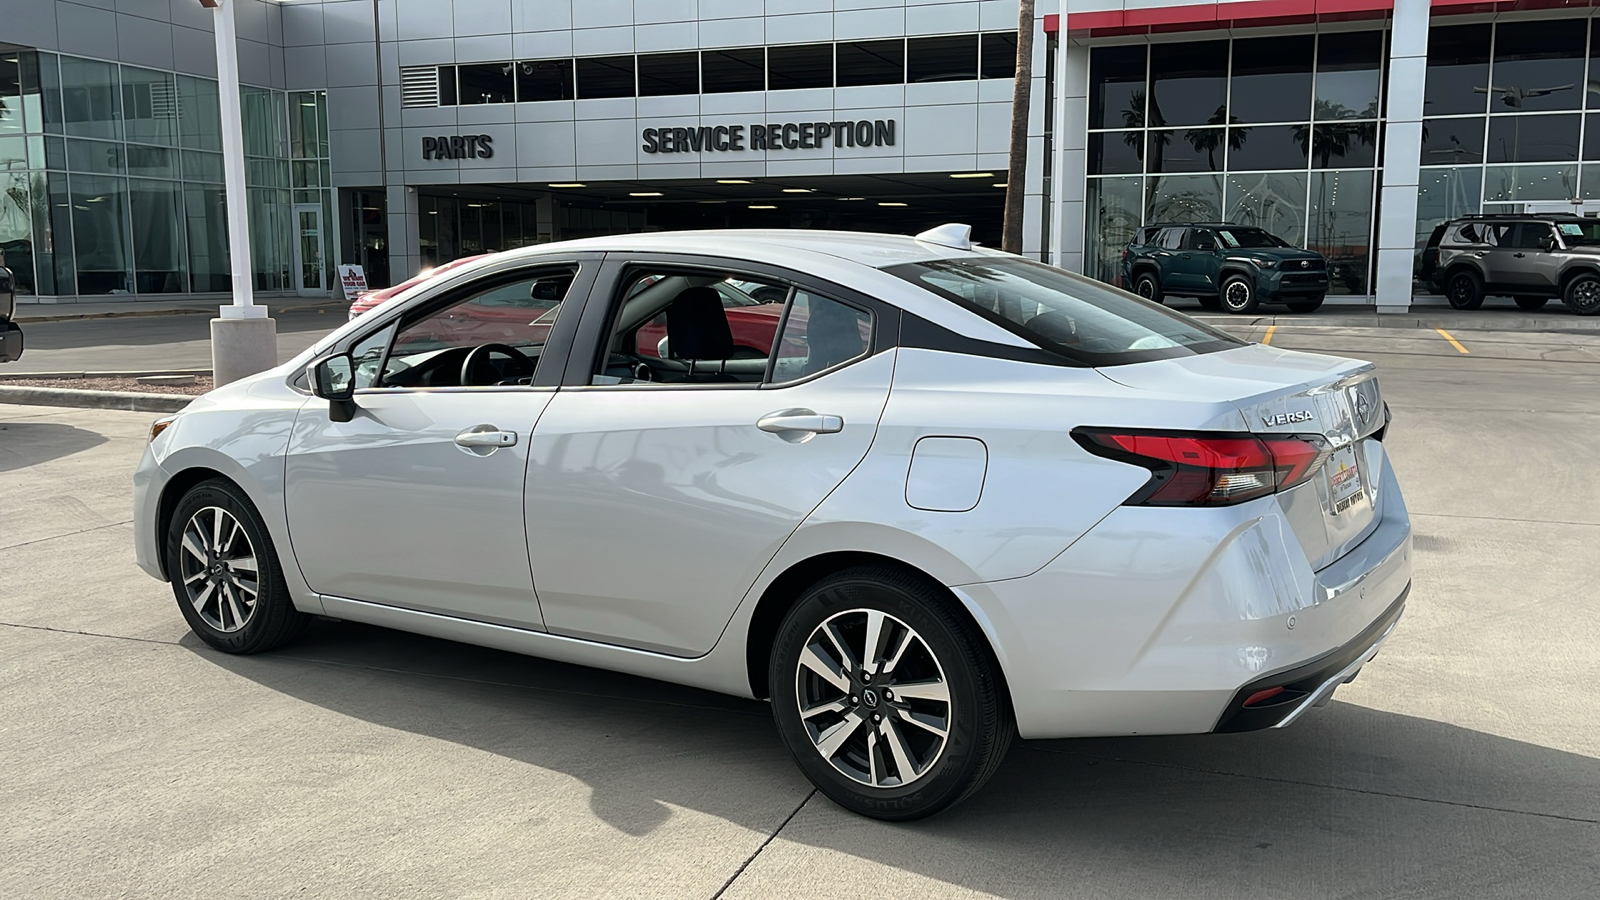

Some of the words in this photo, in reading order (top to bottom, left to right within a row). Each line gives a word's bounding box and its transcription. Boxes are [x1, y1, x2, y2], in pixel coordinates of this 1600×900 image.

[422, 135, 493, 160] PARTS
[643, 125, 745, 152] SERVICE
[750, 119, 896, 150] RECEPTION
[1262, 411, 1314, 427] VERSA
